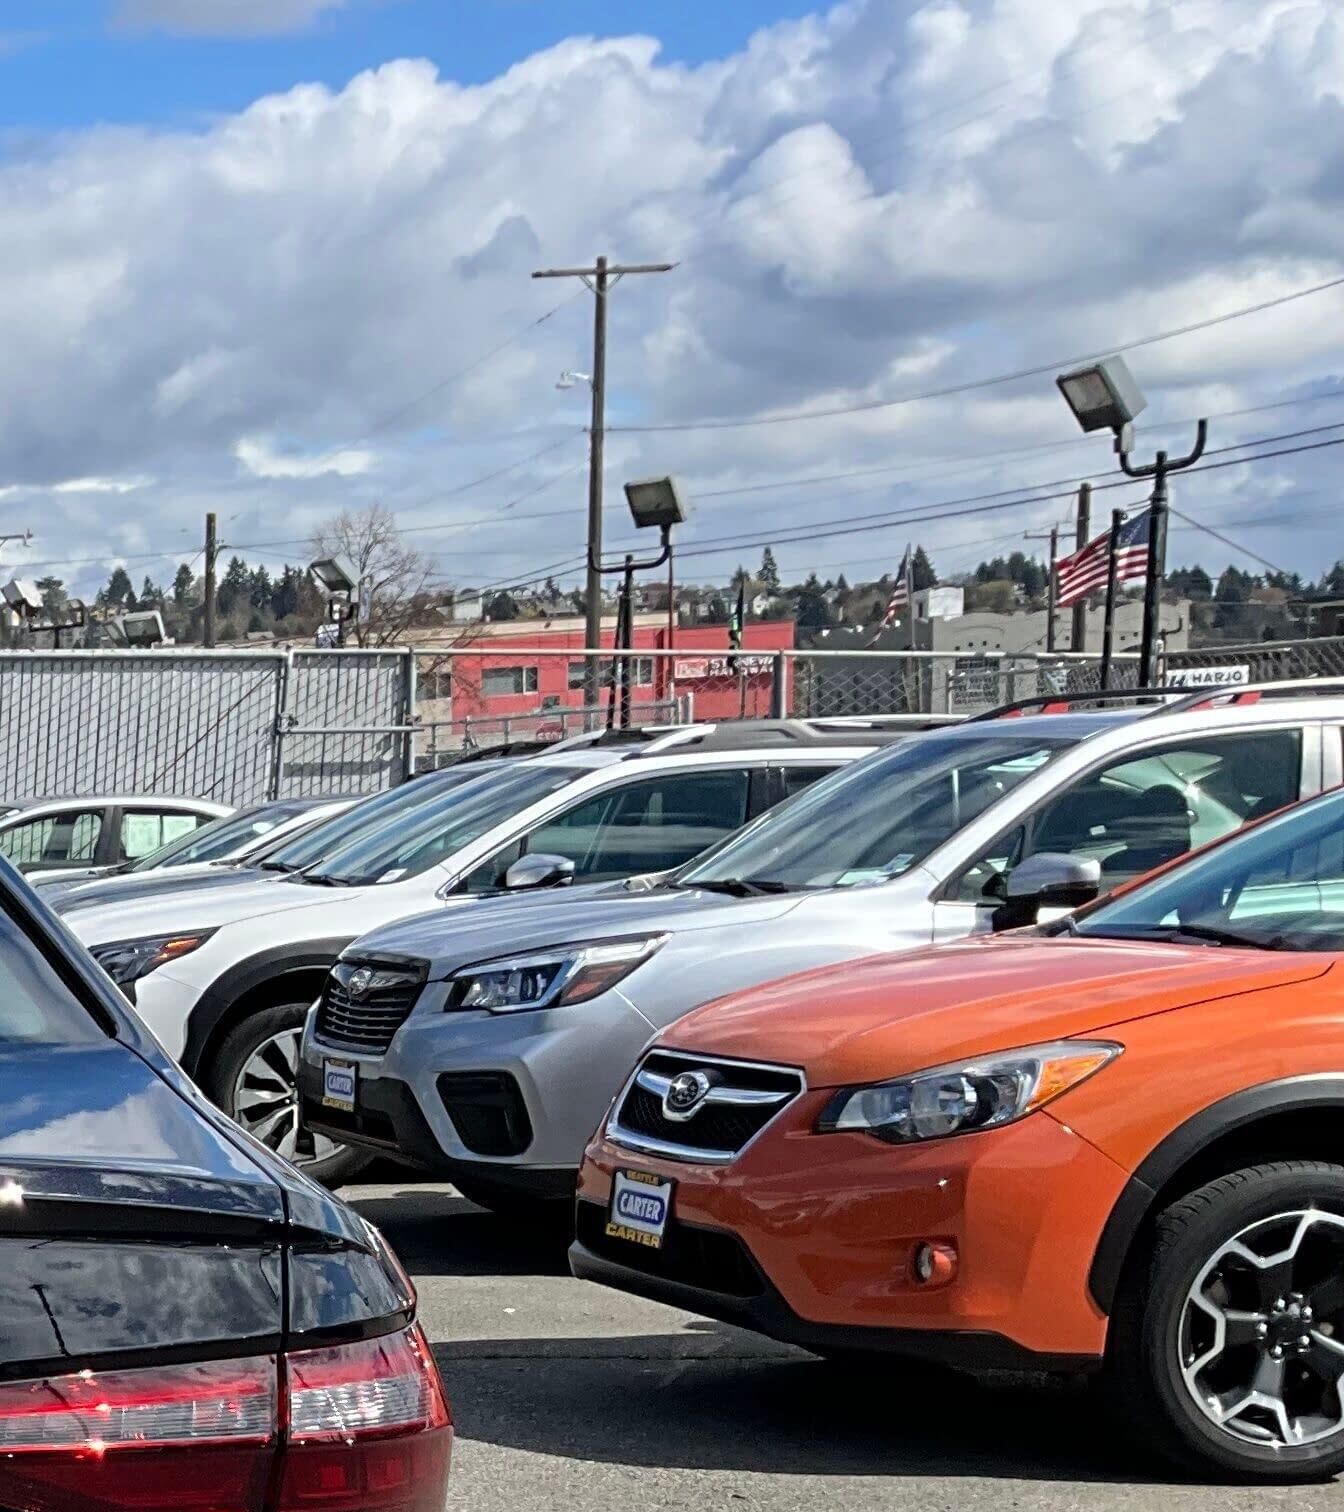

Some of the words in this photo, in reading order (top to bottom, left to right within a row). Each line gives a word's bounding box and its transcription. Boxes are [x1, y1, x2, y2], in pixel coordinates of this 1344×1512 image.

[1192, 671, 1242, 683] HARJO
[620, 1192, 662, 1220] CARTER
[605, 1222, 661, 1249] CARTER
